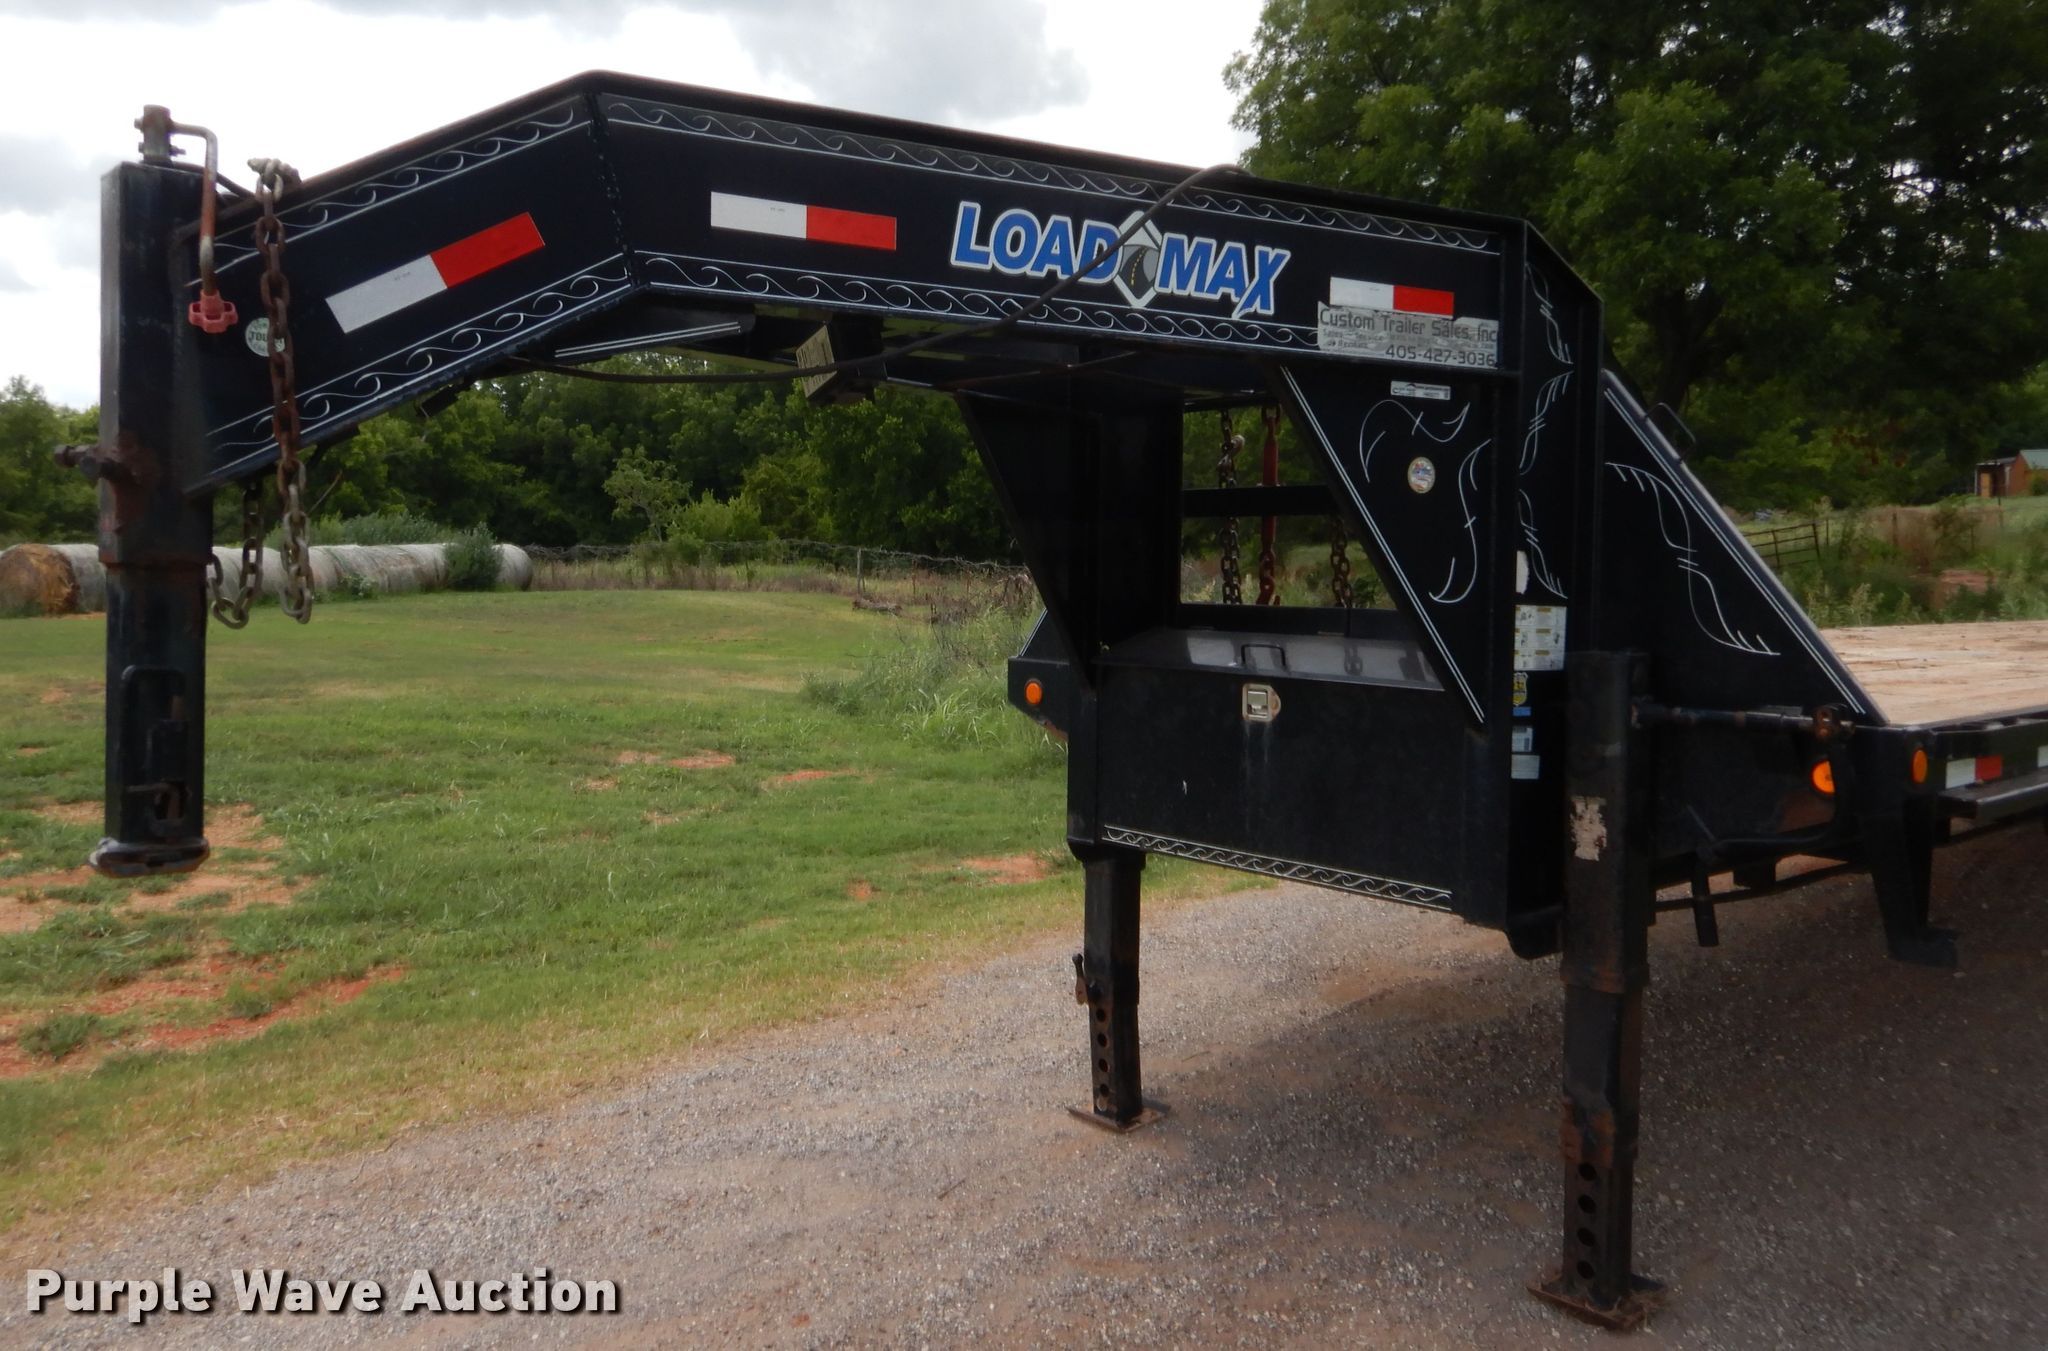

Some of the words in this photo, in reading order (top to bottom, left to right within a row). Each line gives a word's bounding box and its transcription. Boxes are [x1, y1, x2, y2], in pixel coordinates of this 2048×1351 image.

[950, 202, 1123, 284] LOAD
[1154, 232, 1291, 319] MAX
[1320, 308, 1375, 331] Custom
[1381, 313, 1426, 336] Trailer
[1385, 344, 1496, 367] 405-427-3036
